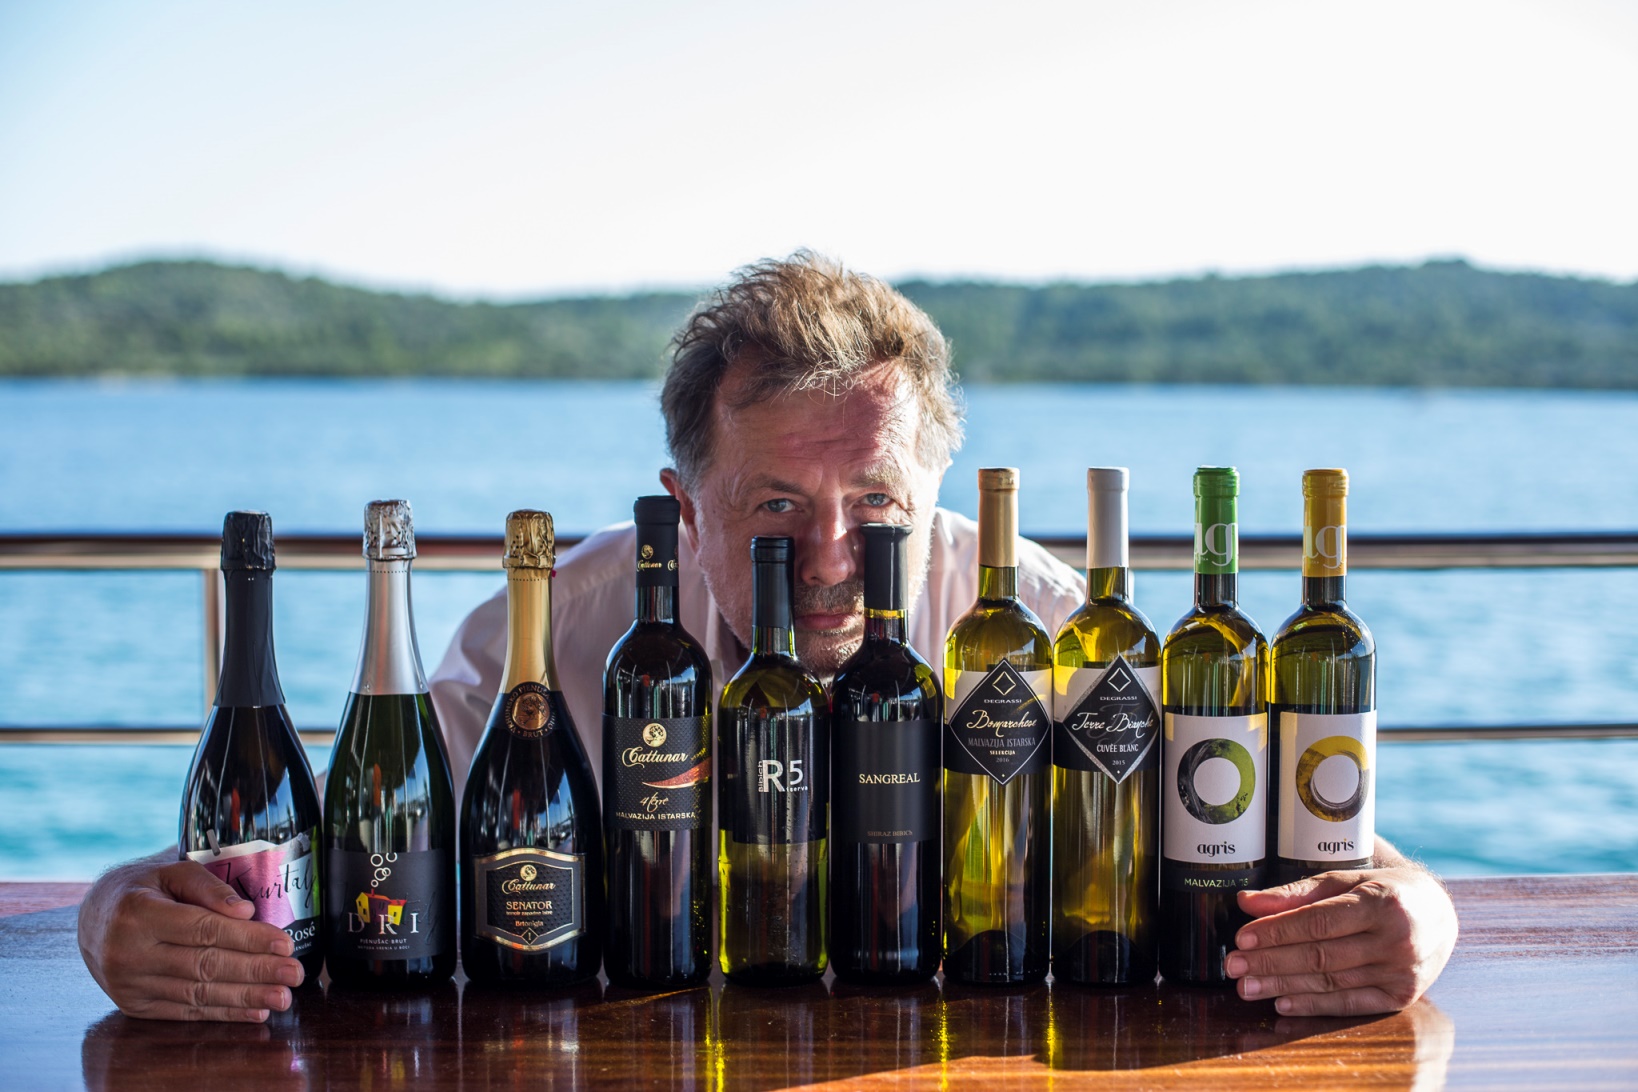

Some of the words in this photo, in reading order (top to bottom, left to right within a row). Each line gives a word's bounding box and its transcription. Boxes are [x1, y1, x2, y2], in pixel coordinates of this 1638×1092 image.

[1071, 712, 1106, 731] Terre
[522, 730, 544, 738] BRUT
[968, 737, 1005, 748] MALVAZIJA
[1006, 737, 1036, 747] ISTARSKA
[1096, 743, 1118, 753] CUVÉE
[1119, 743, 1139, 753] BLANC
[622, 746, 689, 769] Cattunar
[858, 772, 921, 785] SANGREAL
[616, 811, 656, 820] MALVAZIJA
[657, 811, 696, 820] ISTARSKA
[1196, 841, 1236, 858] agris
[1317, 838, 1355, 855] agris
[501, 878, 557, 895] Cattunar
[1184, 877, 1237, 888] MALVAZIJA
[505, 900, 553, 911] SENATOR
